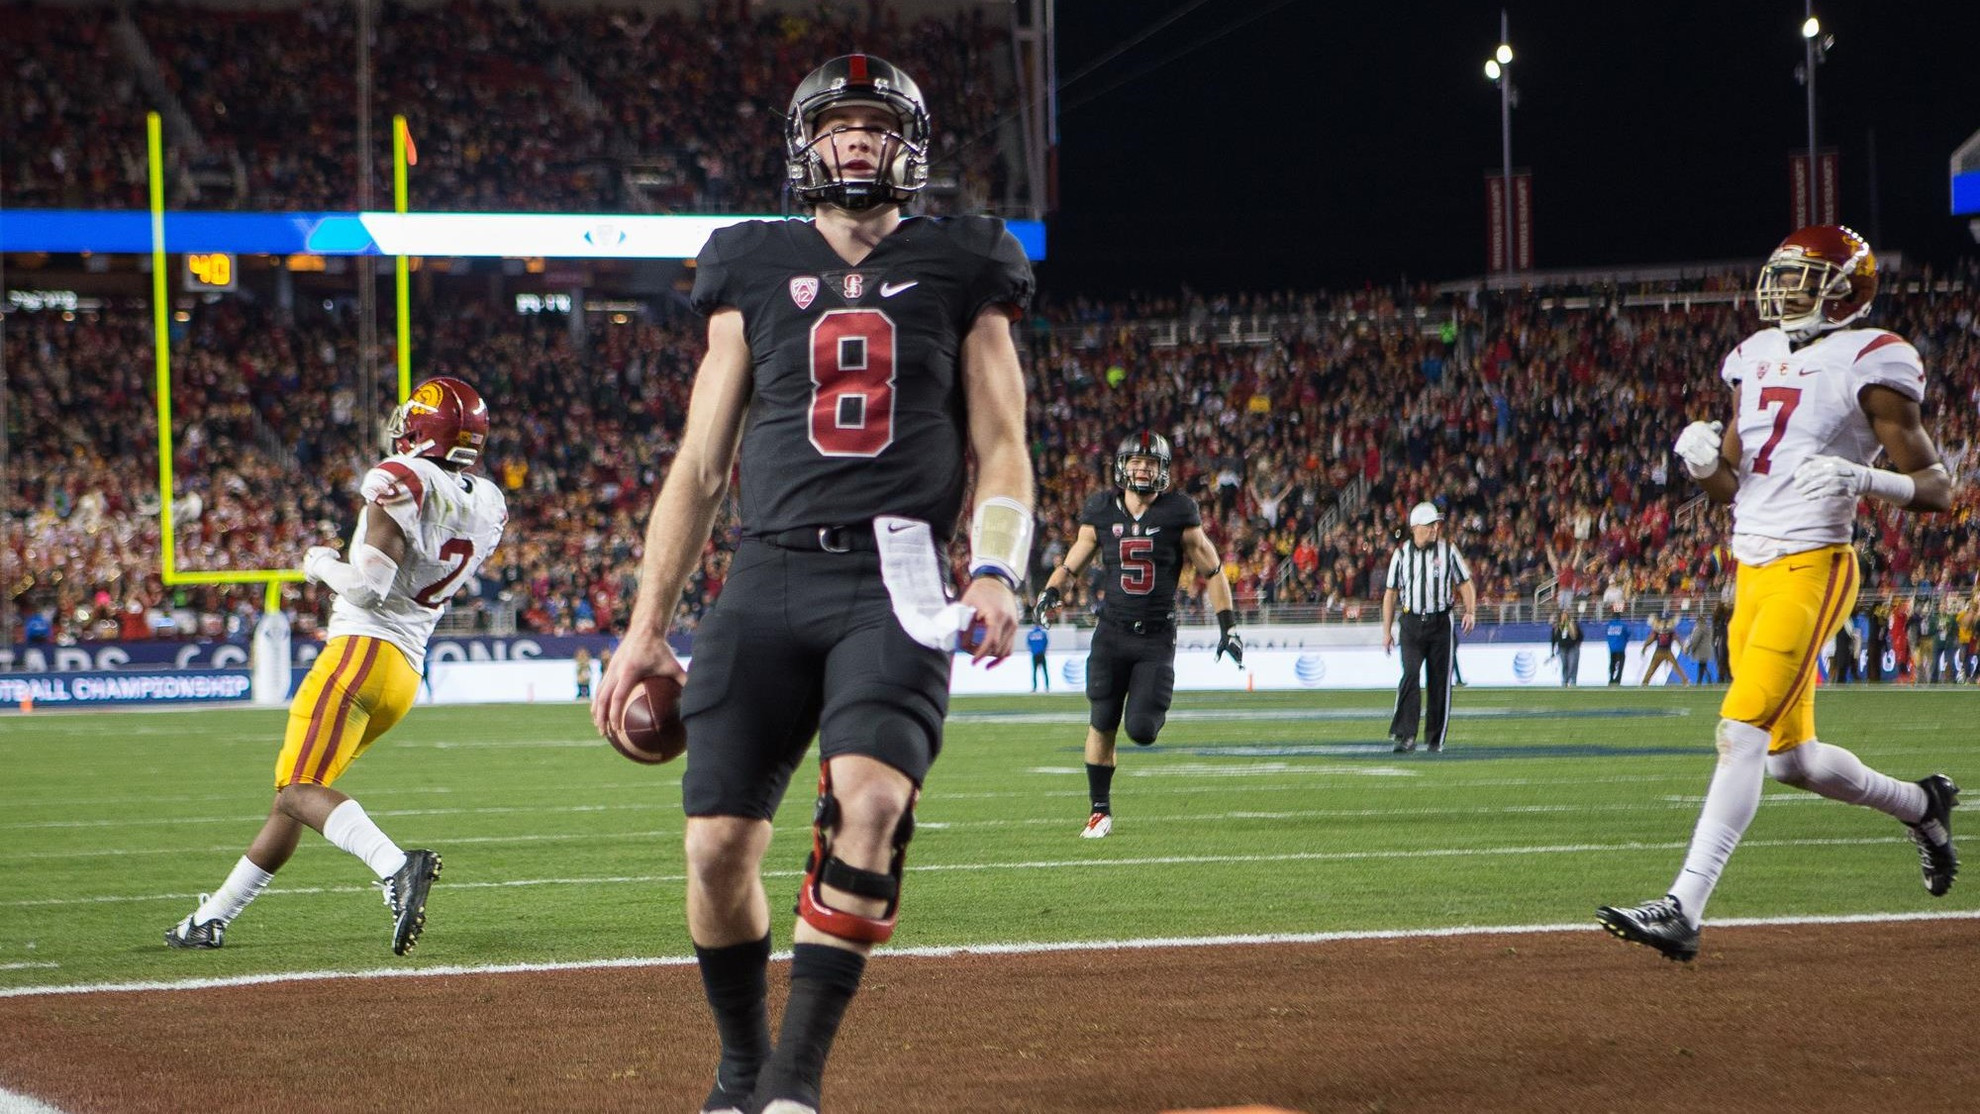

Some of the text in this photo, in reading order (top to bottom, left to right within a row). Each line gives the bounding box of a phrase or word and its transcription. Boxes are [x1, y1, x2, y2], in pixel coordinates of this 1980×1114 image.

[189, 253, 230, 285] 40
[808, 308, 896, 457] 8
[1752, 387, 1802, 475] 7
[411, 538, 474, 609] 2
[1119, 537, 1155, 595] 5
[72, 675, 250, 700] CHAMPIONSHIP
